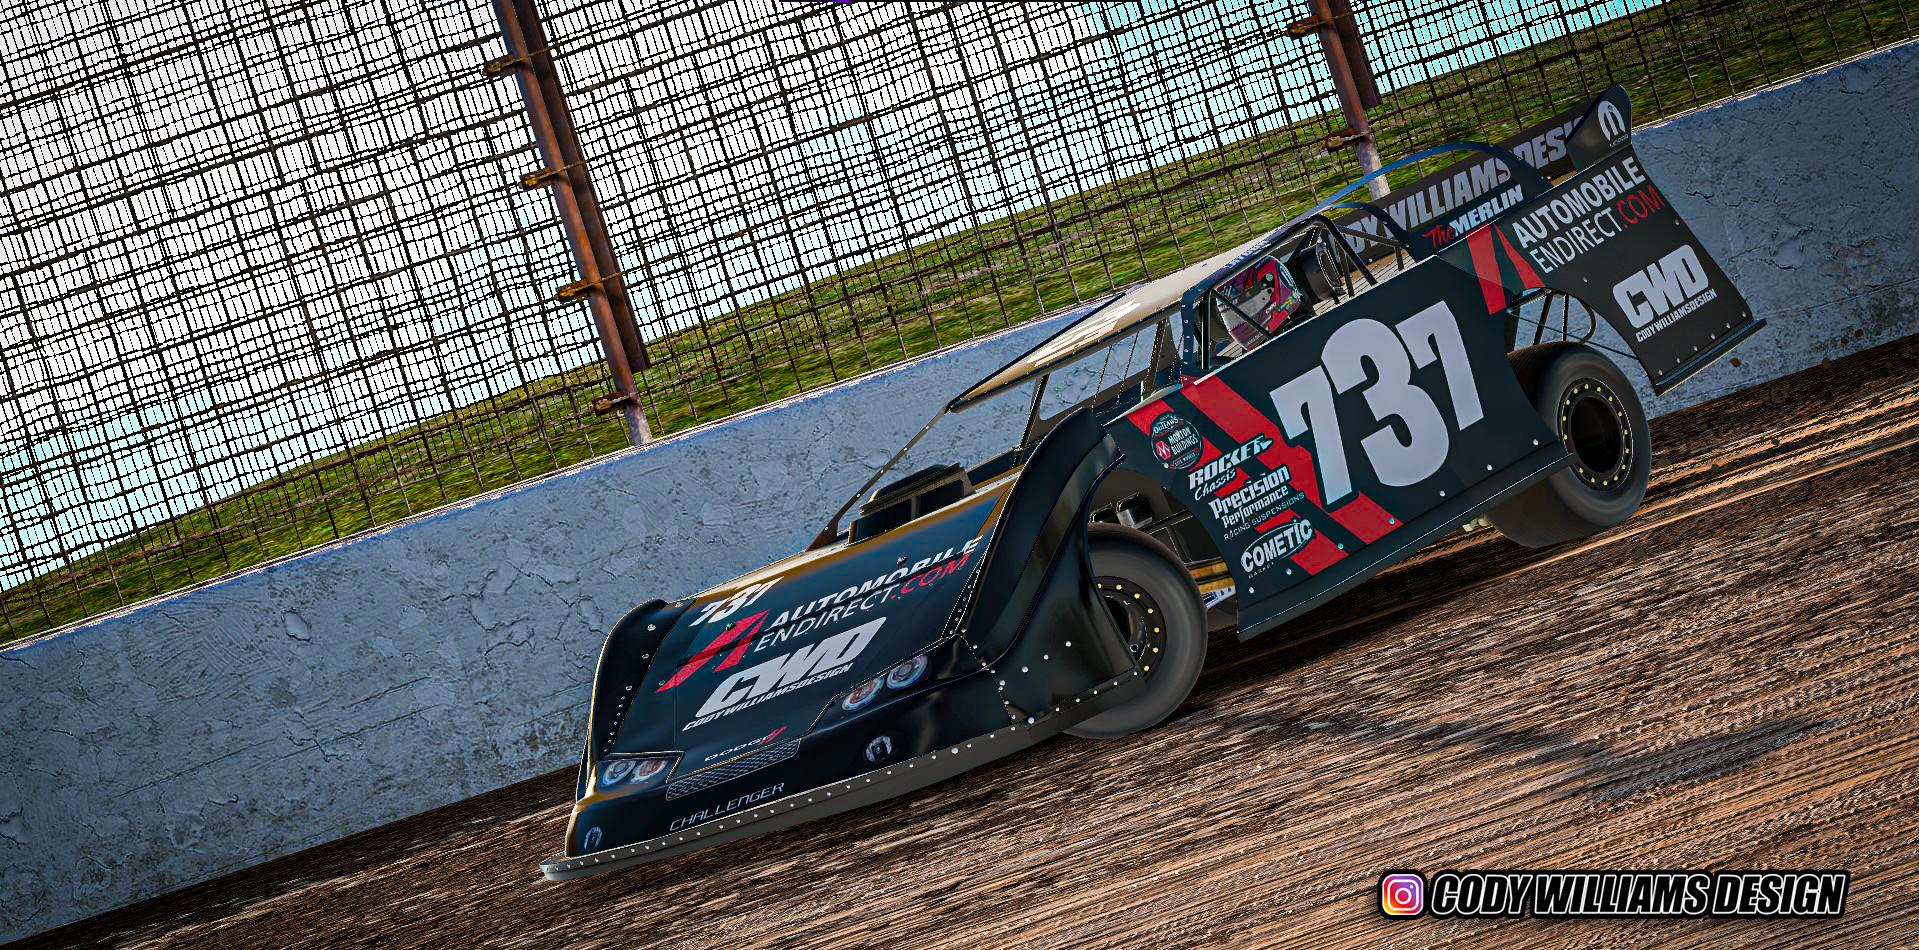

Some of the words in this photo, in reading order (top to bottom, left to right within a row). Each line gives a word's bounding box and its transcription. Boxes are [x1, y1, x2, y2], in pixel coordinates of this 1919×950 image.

[1383, 158, 1511, 239] WILLIAMS
[1513, 115, 1583, 169] DES
[1511, 156, 1646, 249] AUTOMOBILE
[1422, 224, 1456, 249] The
[1449, 184, 1524, 237] MERLIN
[1529, 183, 1666, 274] ENDIRECT.COM
[1612, 244, 1709, 329] CWD
[1635, 288, 1718, 343] CODYWILLIAMSDESIGN
[1269, 300, 1484, 506] 737
[1168, 426, 1191, 445] MORTON
[1170, 434, 1198, 455] BUILDINGS
[1188, 435, 1273, 490] ROCKET
[1194, 468, 1236, 501] Chassis
[1208, 465, 1290, 520] Precision
[1221, 485, 1289, 528] Performance
[1223, 521, 1251, 541] RACING
[1251, 491, 1305, 526] SUSPENSIONS
[1240, 518, 1313, 573] COMETIC
[688, 575, 785, 627] 737
[764, 534, 983, 631] AUTOMOBILE
[695, 616, 887, 718] CWD
[681, 663, 854, 732] CODYWILLIAMSDESIGN
[669, 782, 785, 832] CHALLENGER
